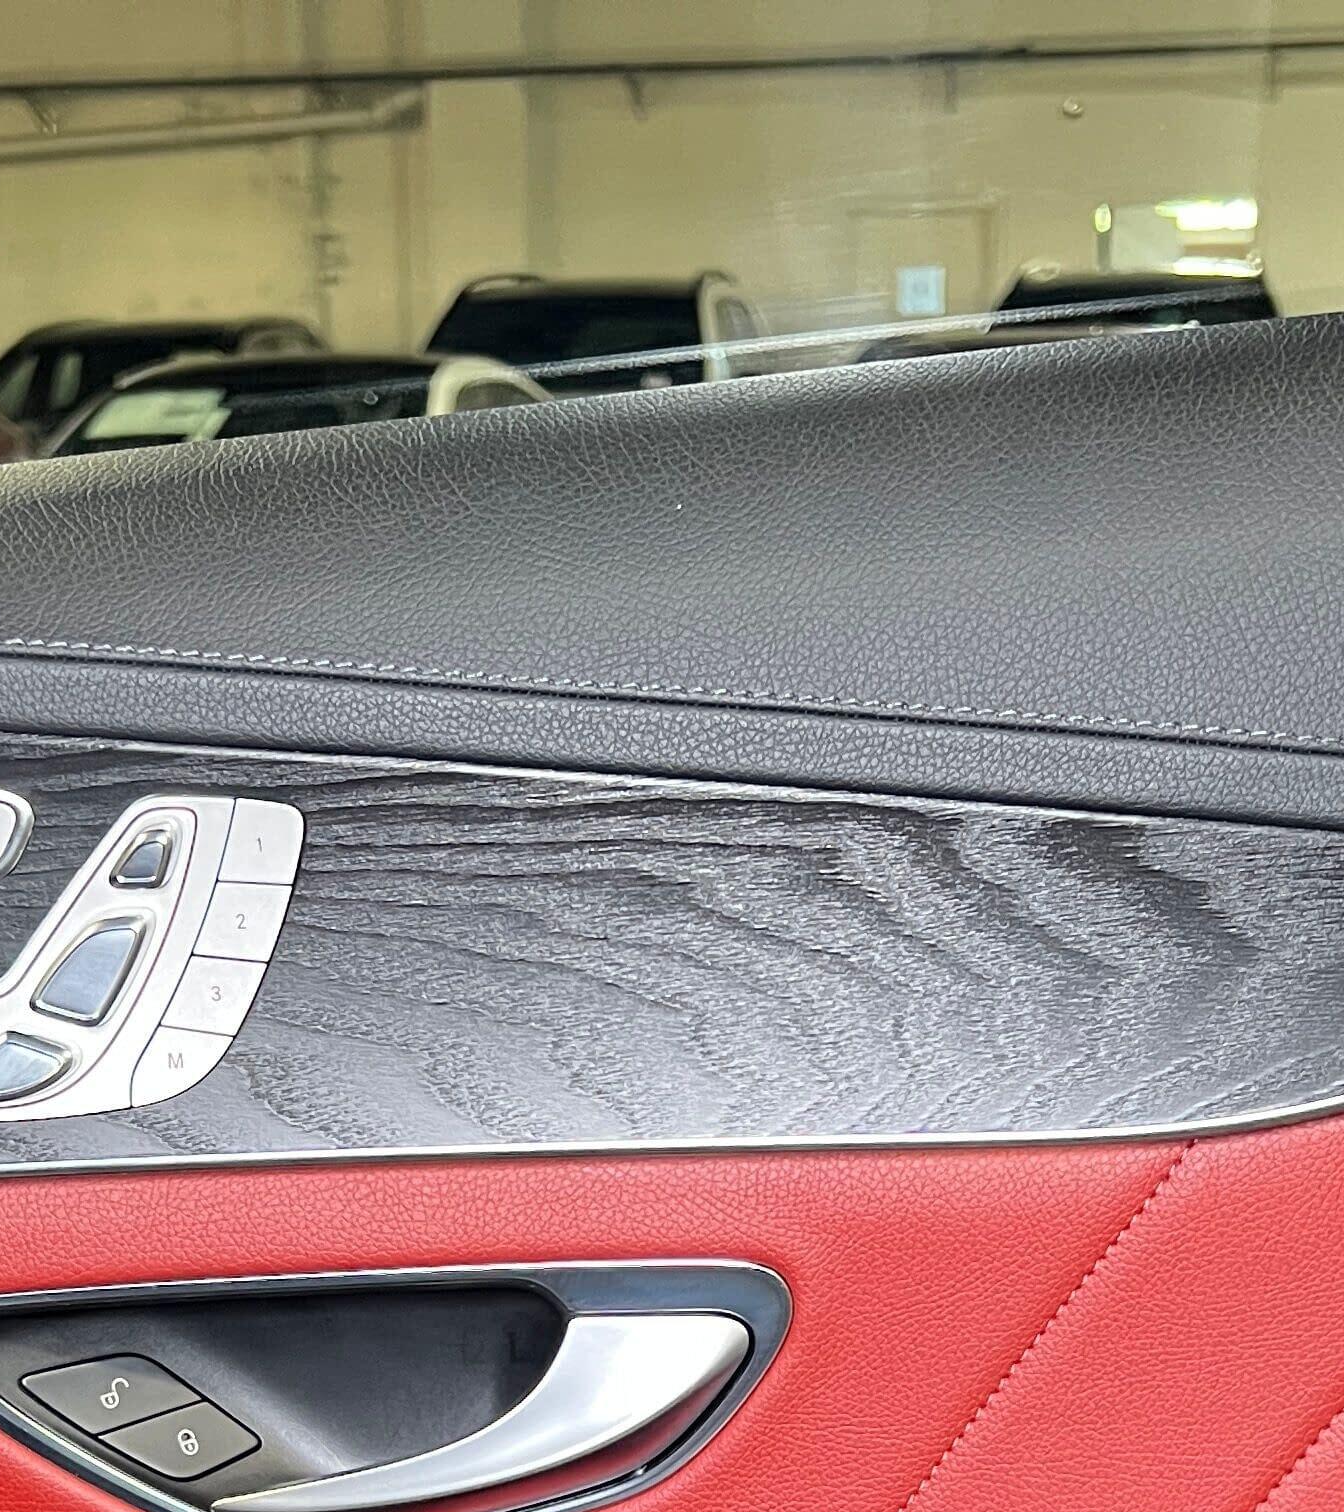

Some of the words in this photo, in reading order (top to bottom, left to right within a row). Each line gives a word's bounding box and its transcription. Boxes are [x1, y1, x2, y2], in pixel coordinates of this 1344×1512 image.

[235, 913, 247, 930] 2
[211, 985, 222, 1002] 3
[167, 1052, 185, 1070] M
